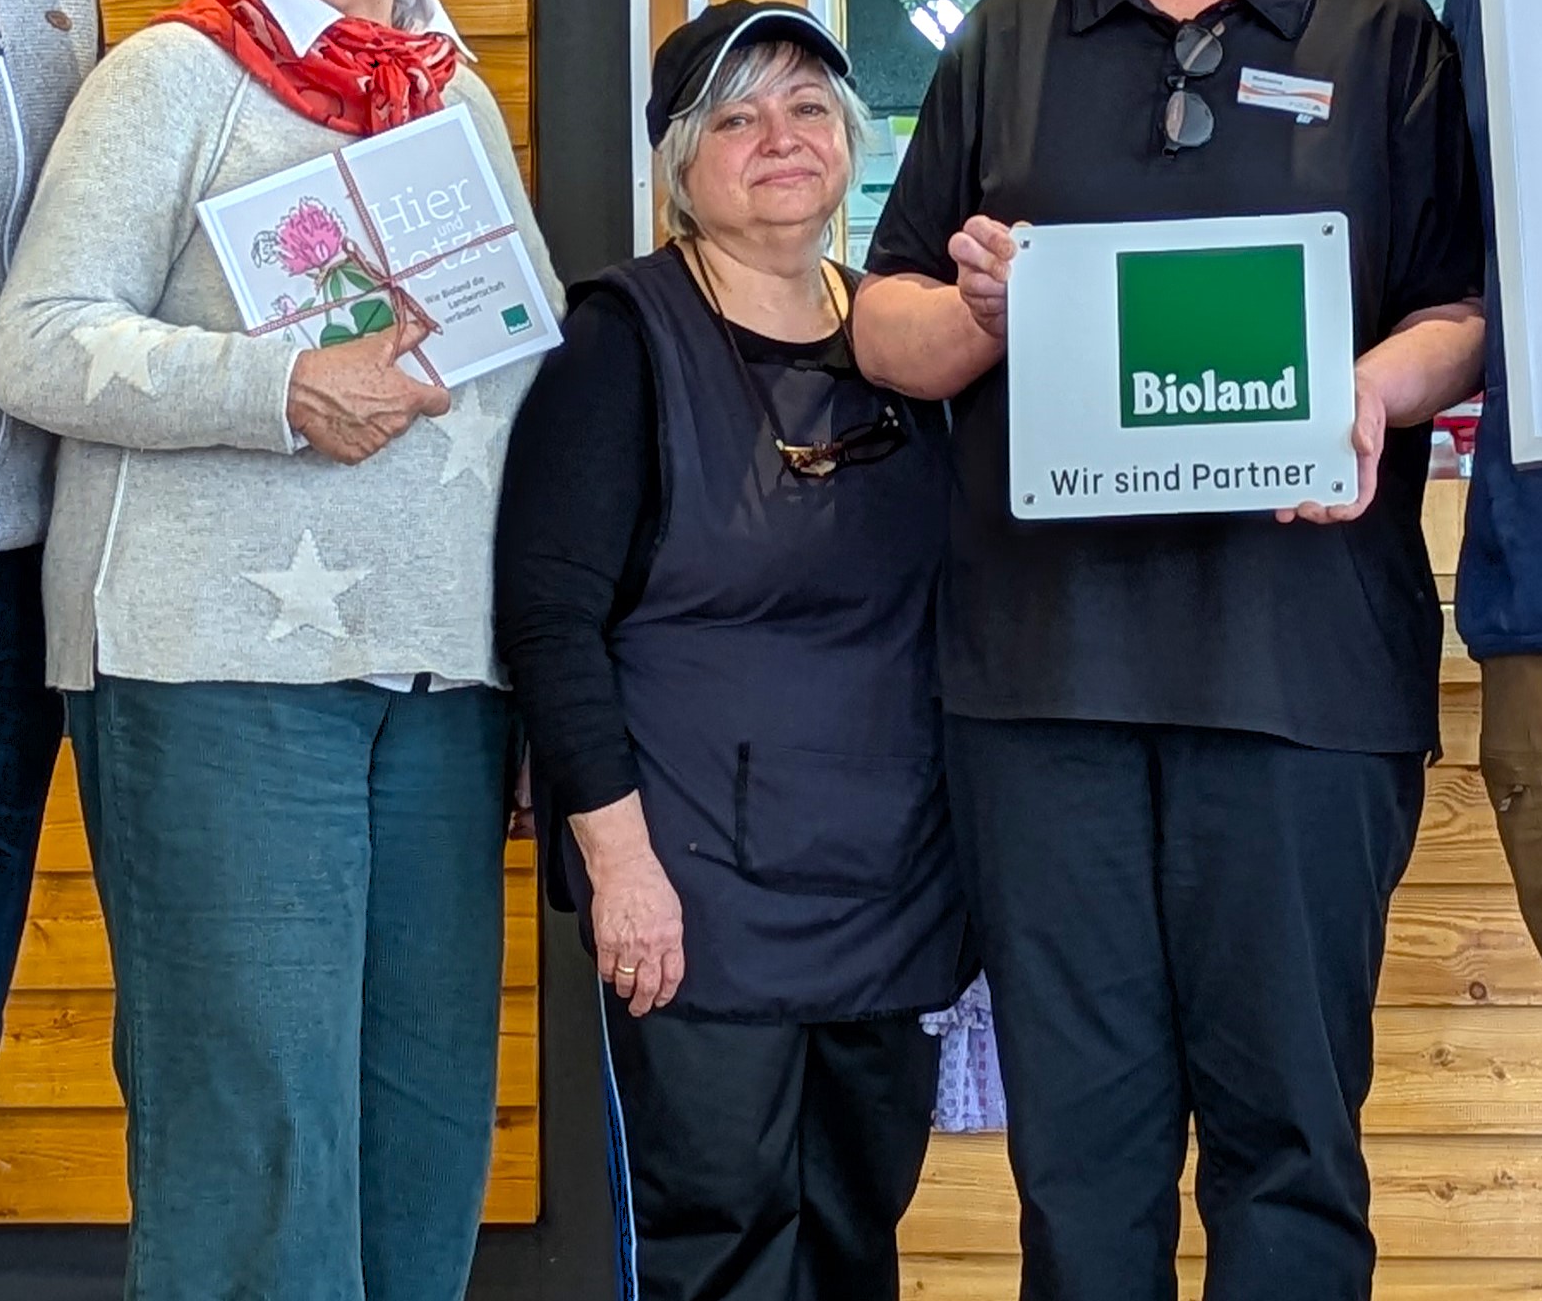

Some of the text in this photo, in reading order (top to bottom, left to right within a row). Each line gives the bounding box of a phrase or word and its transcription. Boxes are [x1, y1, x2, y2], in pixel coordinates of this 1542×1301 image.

[368, 178, 471, 243] Hier
[437, 214, 465, 238] und
[448, 281, 506, 310] Landwirtschaft
[1132, 366, 1297, 417] Bioland
[1050, 461, 1316, 496] Wir sind Partner
